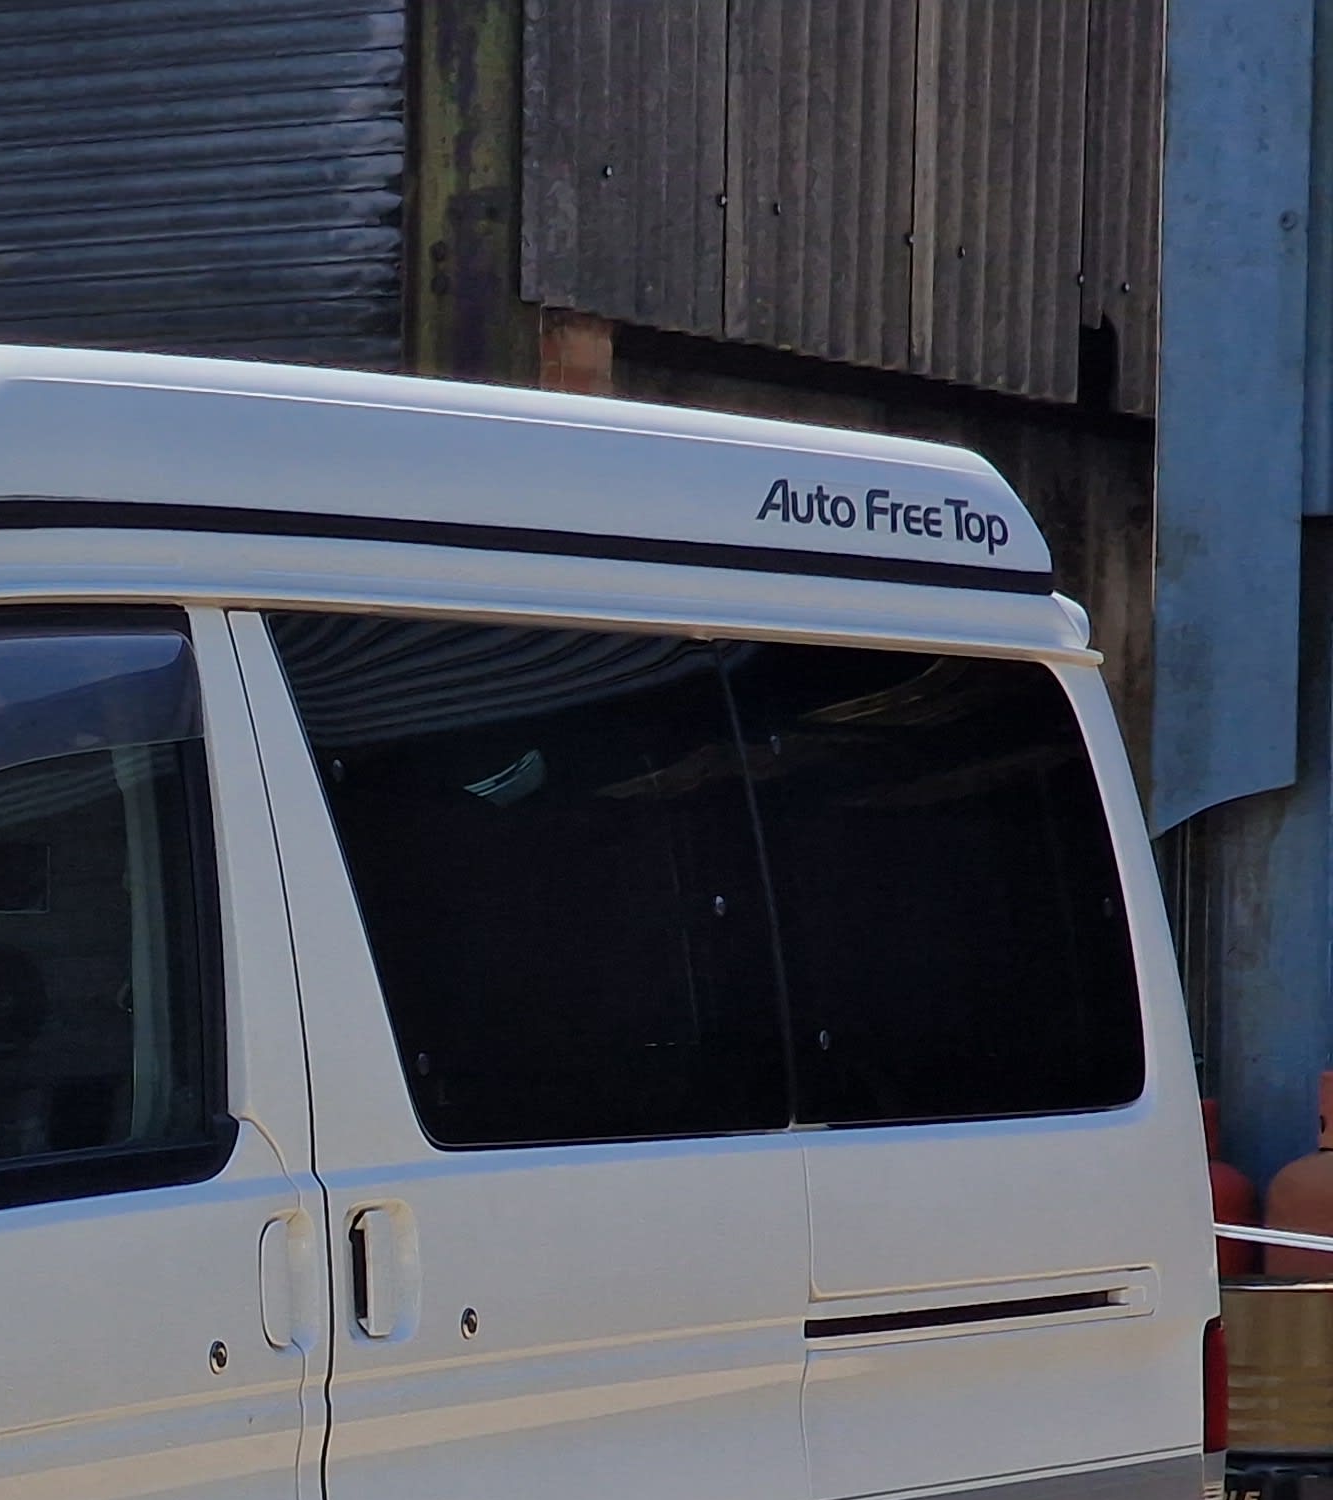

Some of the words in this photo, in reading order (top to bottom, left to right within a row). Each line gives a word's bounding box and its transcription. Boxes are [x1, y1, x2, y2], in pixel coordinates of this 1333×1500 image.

[756, 478, 856, 528] Auto
[865, 488, 943, 538] Free
[944, 497, 1009, 555] Top
